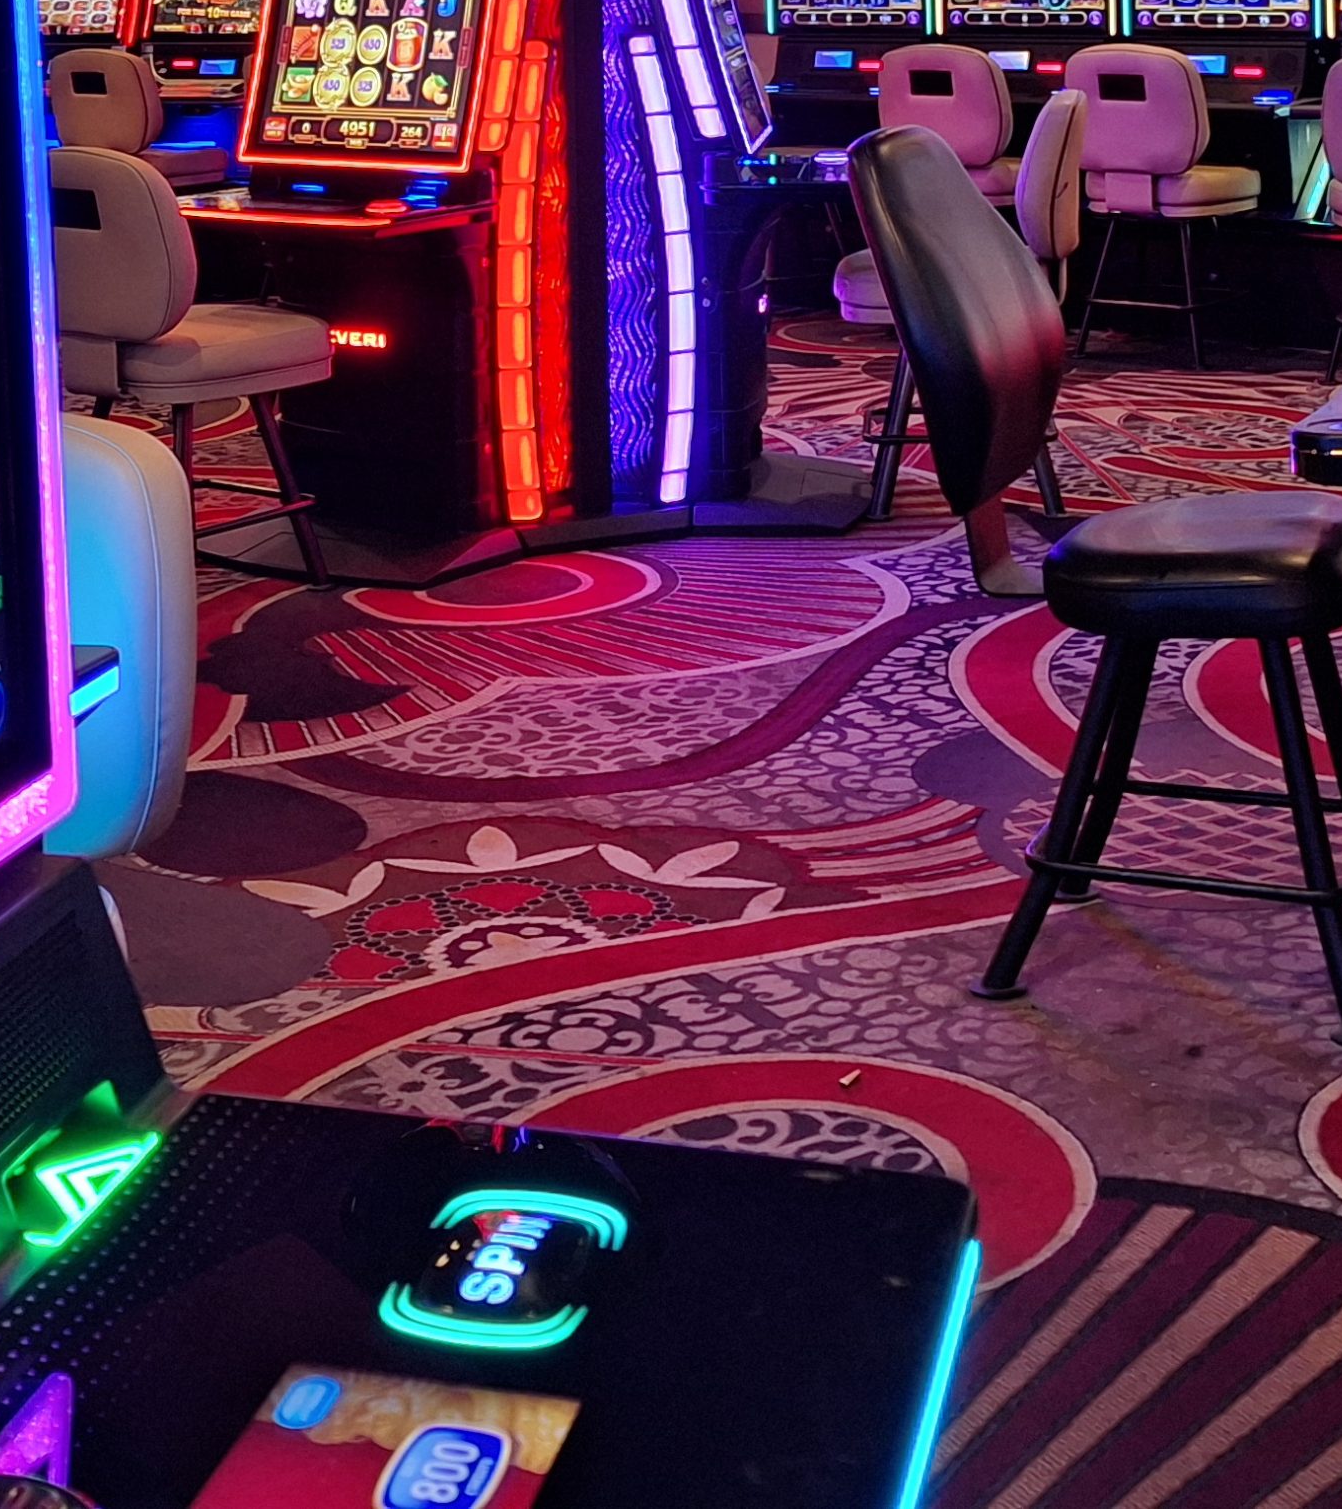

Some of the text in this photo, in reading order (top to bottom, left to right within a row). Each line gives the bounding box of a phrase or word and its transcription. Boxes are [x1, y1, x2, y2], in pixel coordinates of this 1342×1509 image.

[429, 28, 457, 59] K
[387, 72, 415, 102] K
[339, 120, 375, 138] 4951
[401, 125, 422, 139] 264
[459, 1213, 555, 1305] SPIN
[409, 1440, 481, 1505] 800
